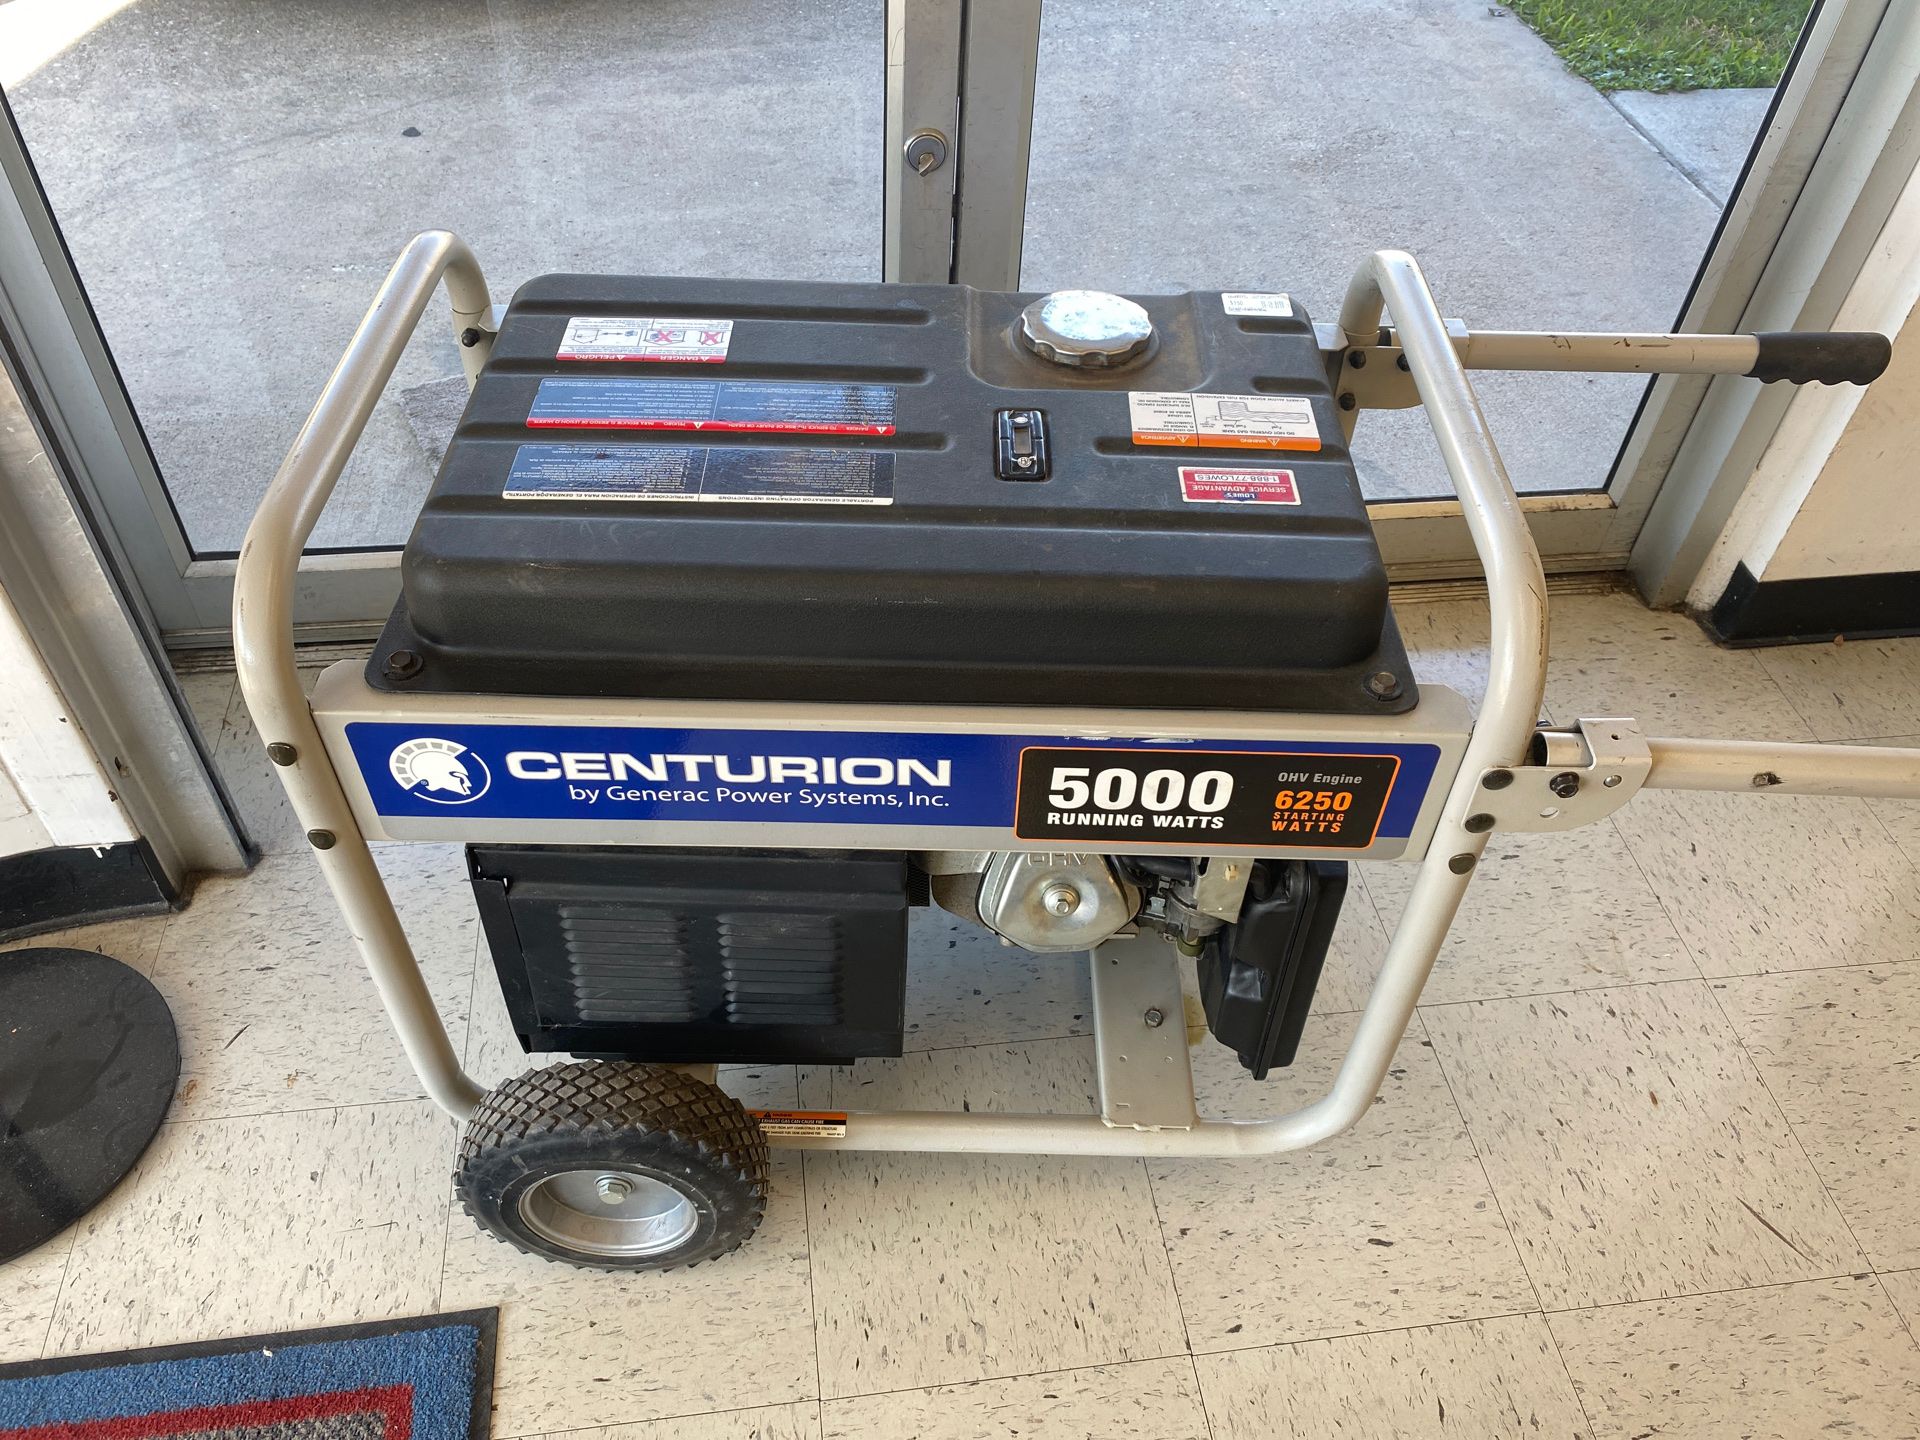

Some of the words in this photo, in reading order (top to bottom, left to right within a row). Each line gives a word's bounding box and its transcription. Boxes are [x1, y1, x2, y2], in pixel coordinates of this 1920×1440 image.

[1197, 474, 1278, 483] 1-888-77LOWES
[505, 751, 951, 787] CENTURION
[1278, 772, 1310, 782] OHV
[1313, 773, 1363, 786] Engine
[569, 784, 600, 804] by
[606, 785, 710, 802] Generac
[716, 787, 792, 803] Power
[799, 788, 903, 808] Systems,
[908, 791, 950, 807] Inc.
[1048, 767, 1235, 813] 5000
[1274, 789, 1354, 811] 6250
[1047, 812, 1144, 827] RUNNING
[1152, 815, 1225, 829] WATTS
[1273, 811, 1345, 822] STARTING
[1271, 821, 1342, 833] WATTS
